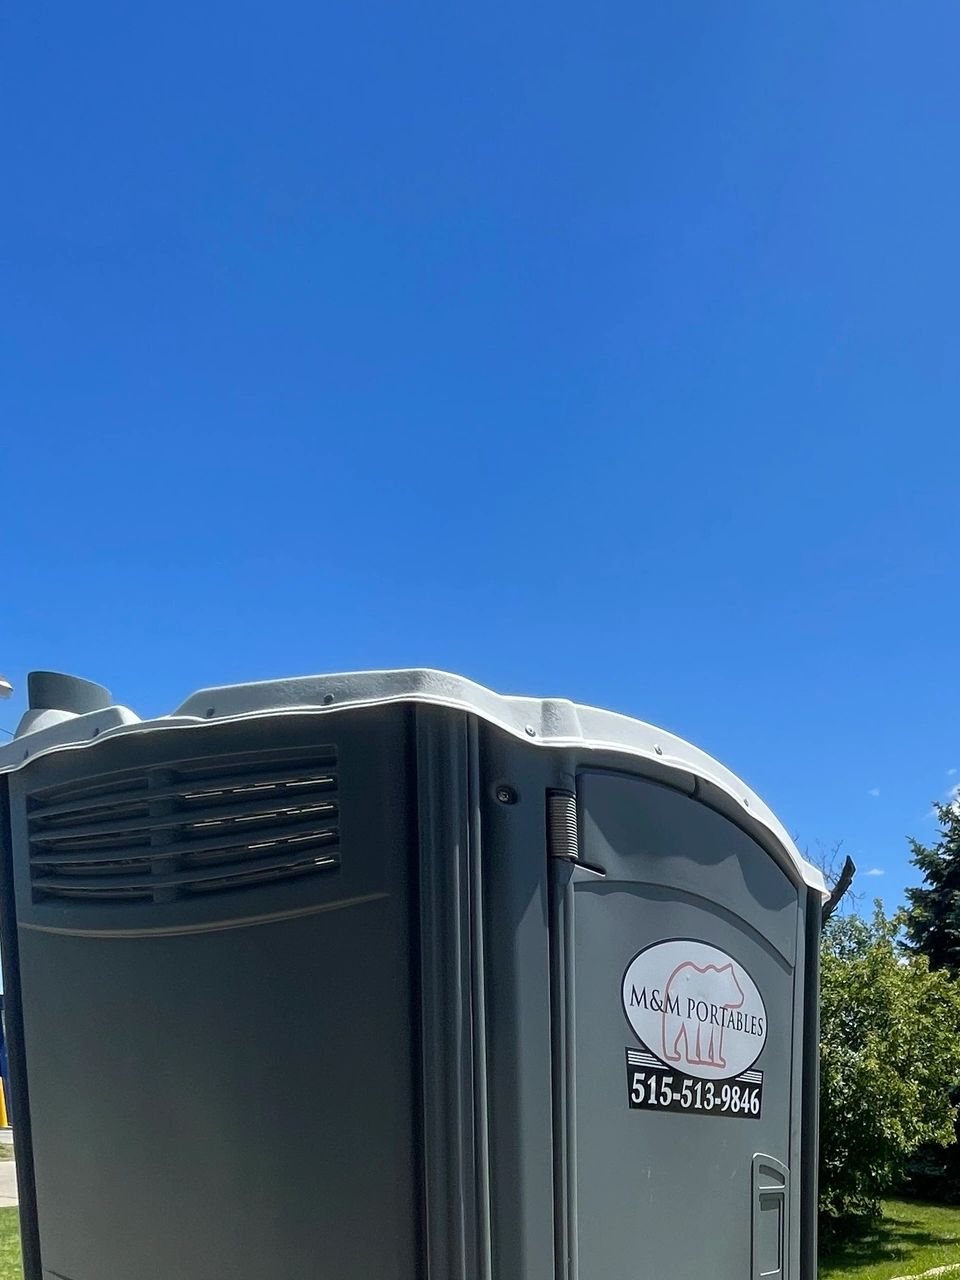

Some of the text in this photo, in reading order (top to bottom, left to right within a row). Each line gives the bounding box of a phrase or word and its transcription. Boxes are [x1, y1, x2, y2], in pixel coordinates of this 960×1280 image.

[630, 984, 764, 1037] M&M PORTABLES
[631, 1072, 760, 1115] 515-513-9846
